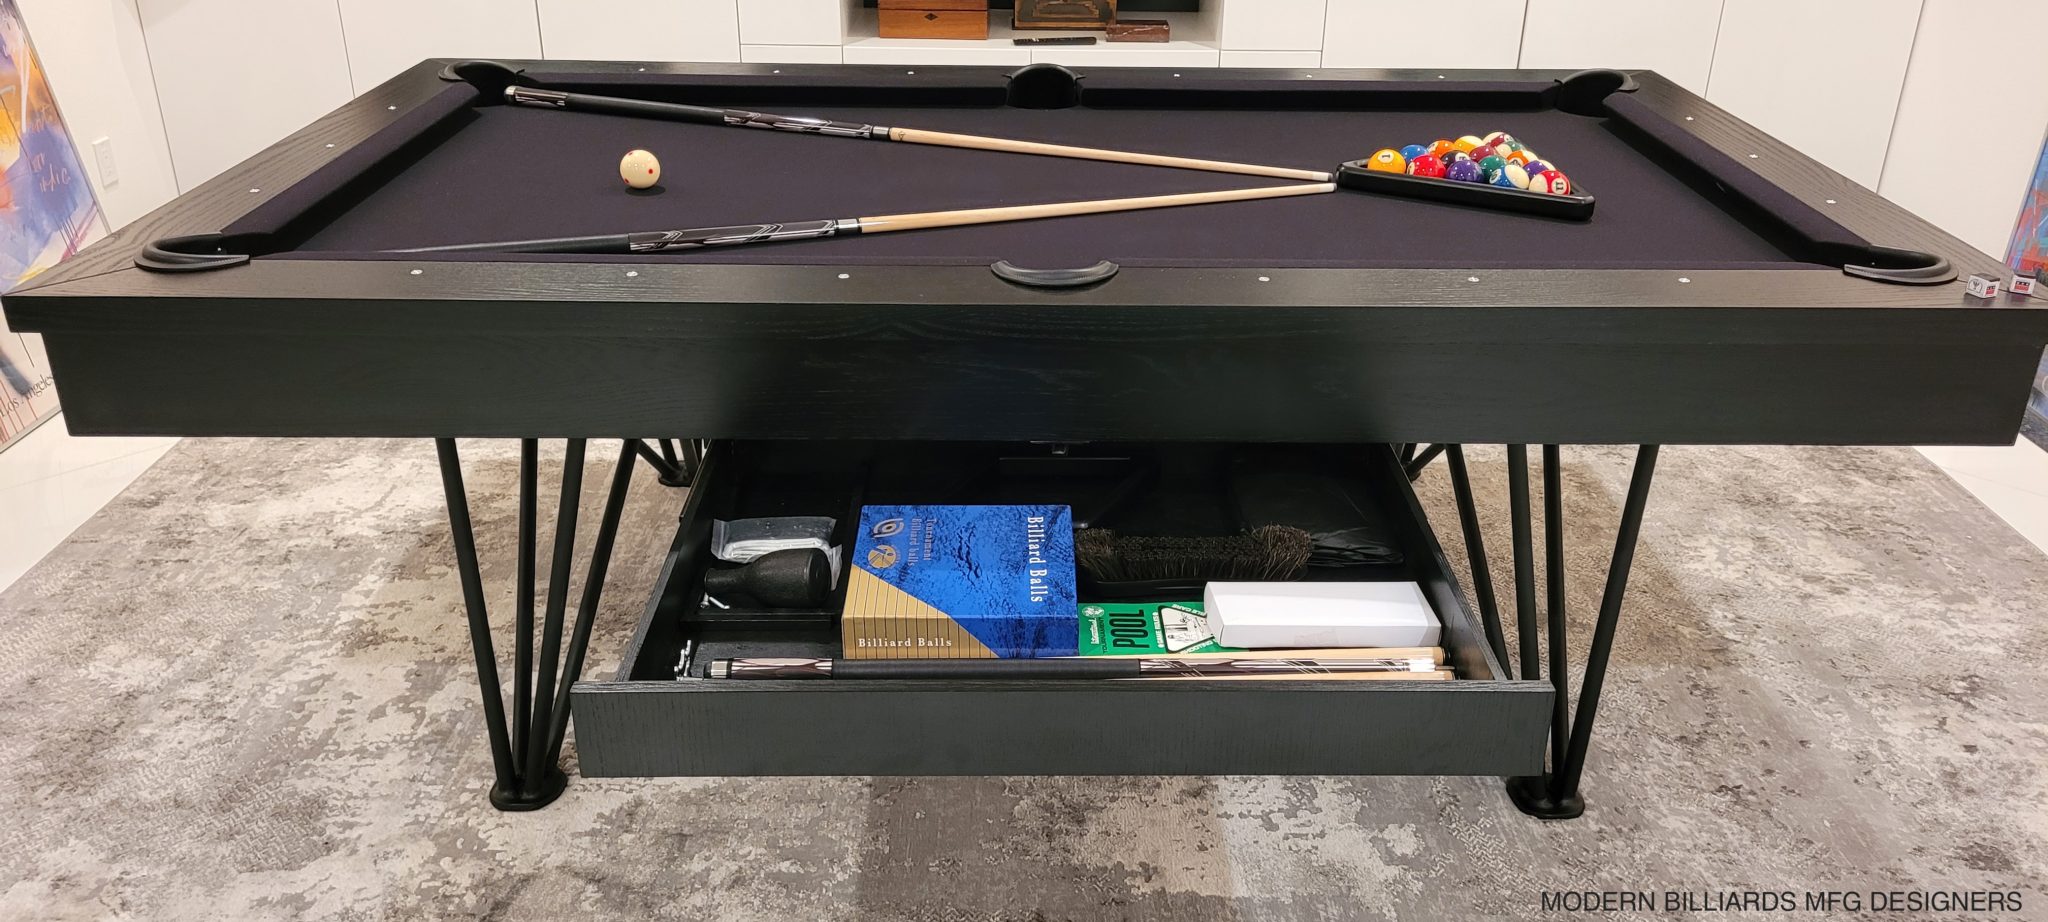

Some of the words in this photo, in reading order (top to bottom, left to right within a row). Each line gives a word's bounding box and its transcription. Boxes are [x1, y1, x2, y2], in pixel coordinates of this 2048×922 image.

[909, 518, 922, 545] Billiard
[923, 517, 937, 561] Tournament
[1027, 516, 1047, 565] Billiard
[907, 547, 919, 567] balls
[1030, 569, 1048, 603] Balls
[858, 637, 912, 648] Billiard
[918, 637, 953, 648] Balls
[1108, 609, 1150, 649] POOL
